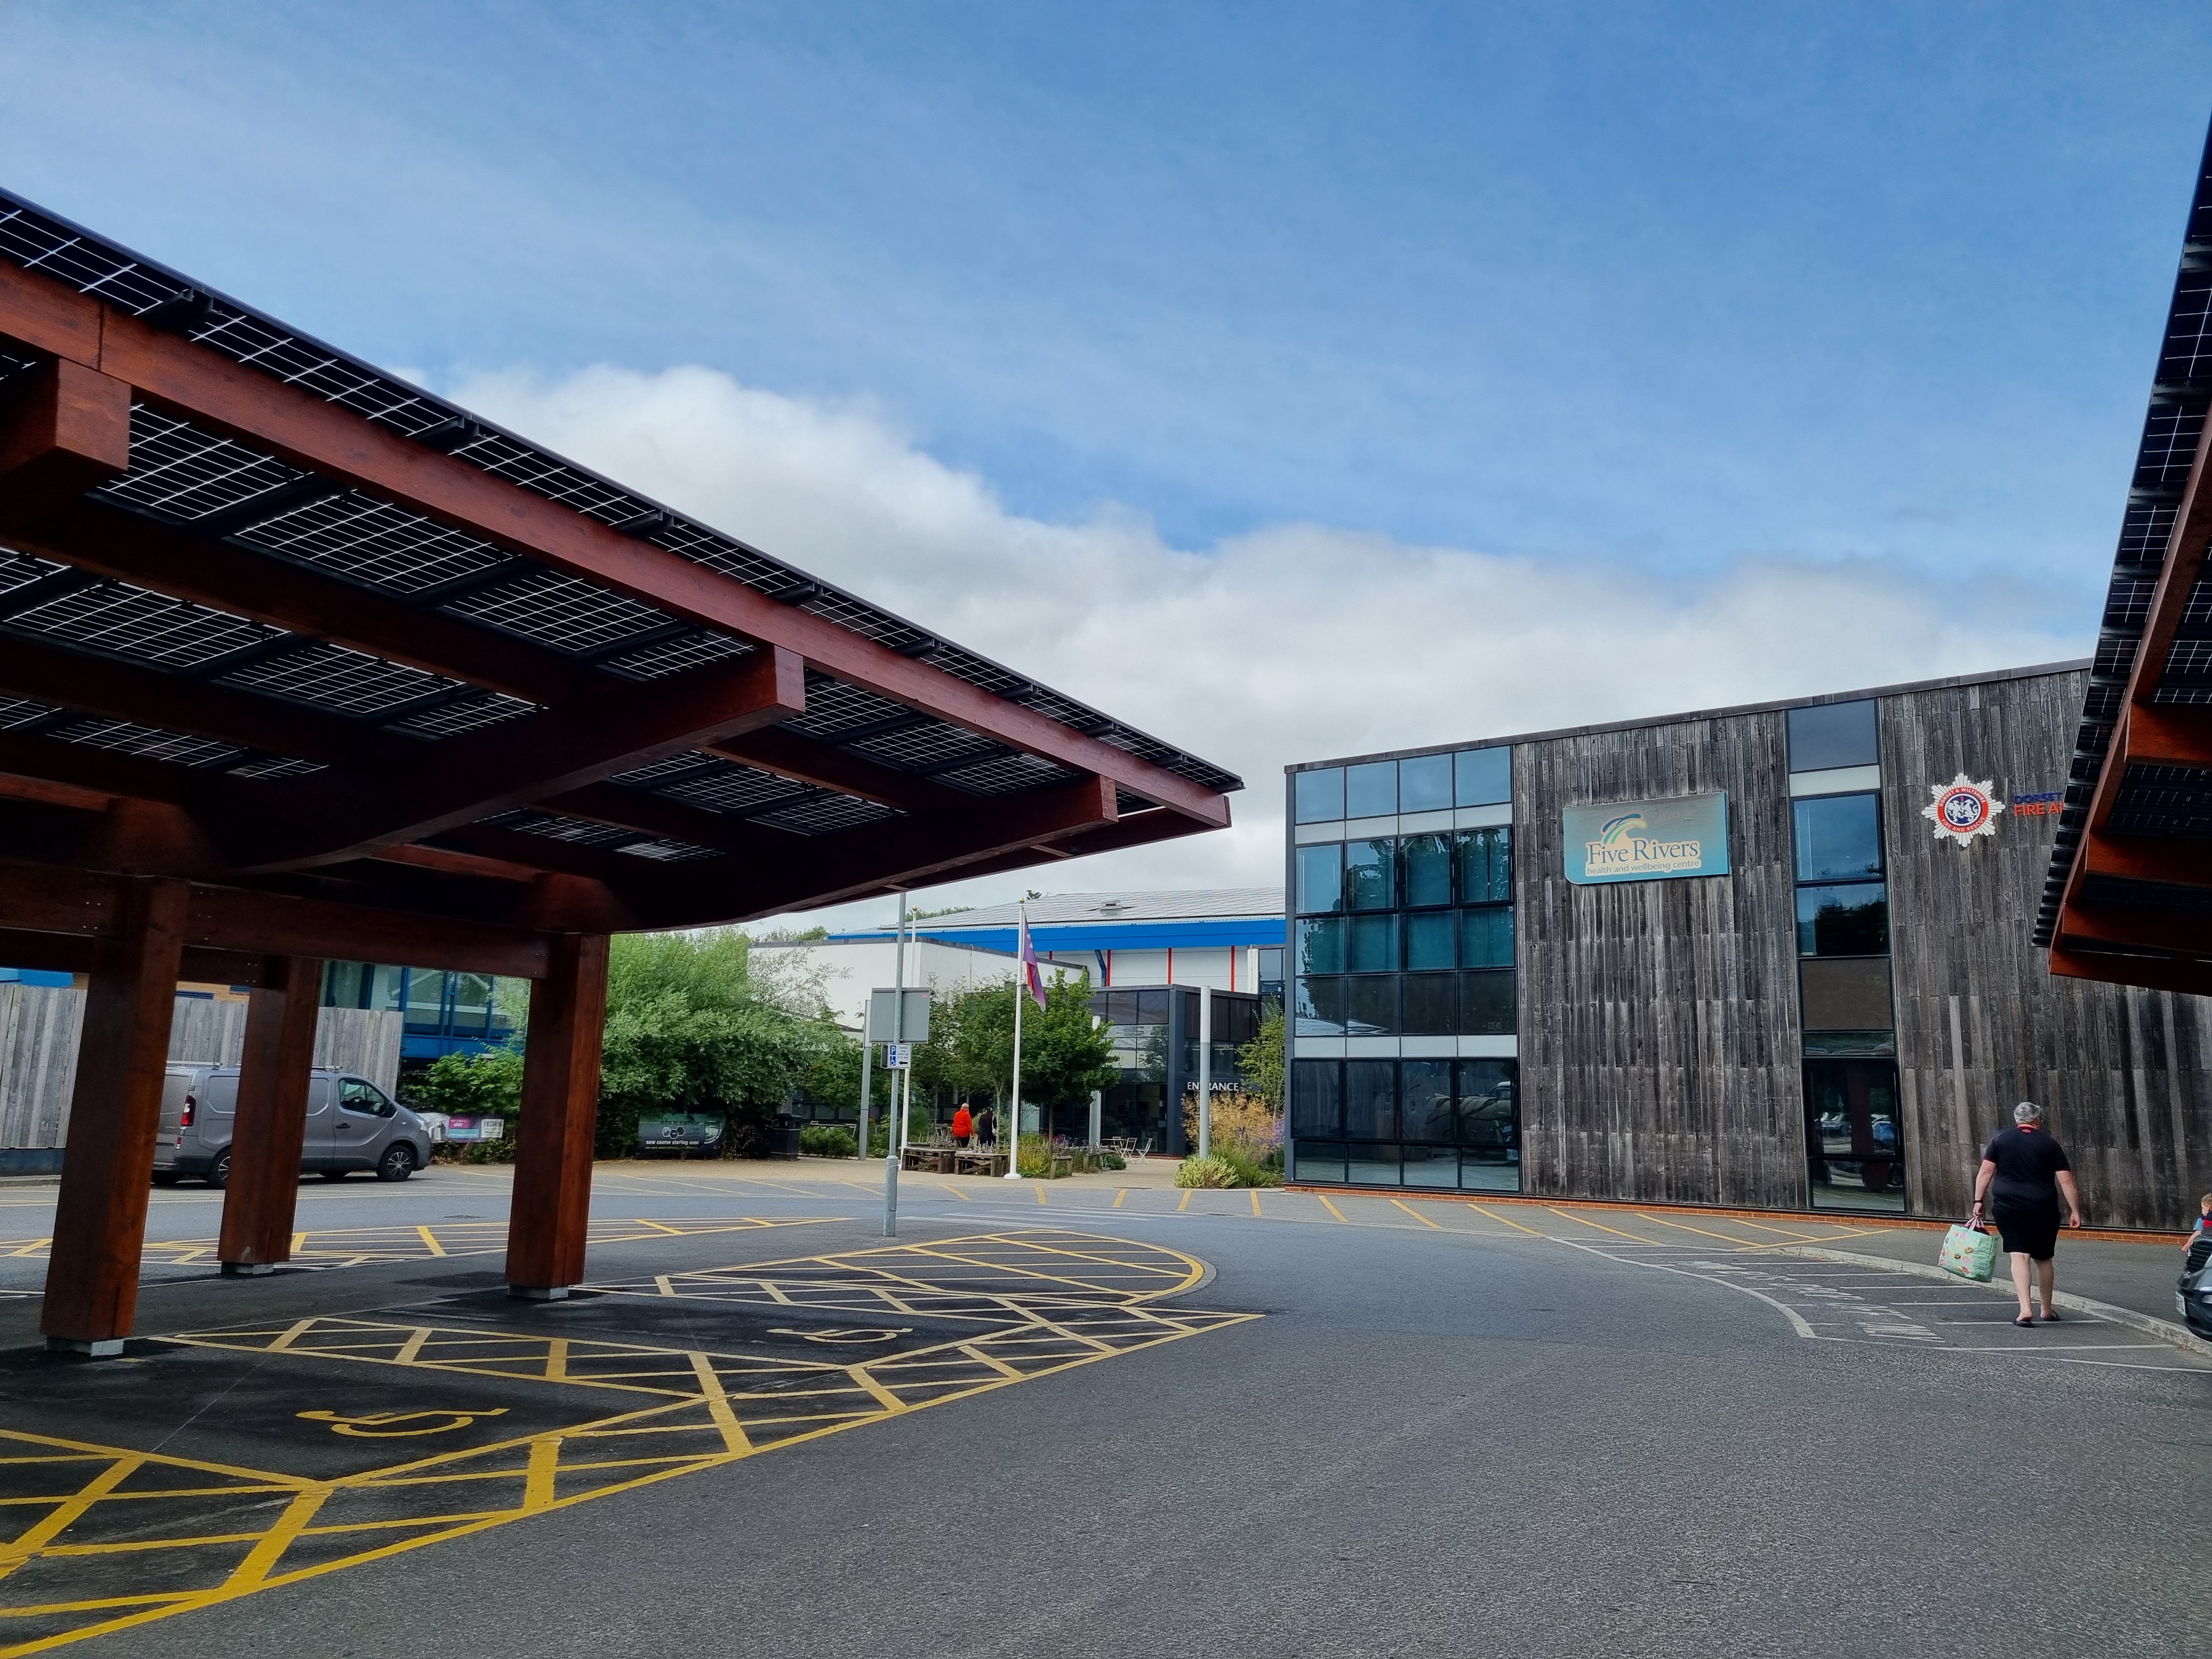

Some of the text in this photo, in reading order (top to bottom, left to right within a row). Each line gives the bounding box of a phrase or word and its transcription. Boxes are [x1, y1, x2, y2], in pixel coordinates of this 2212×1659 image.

[1939, 791, 1954, 806] DORSET
[1961, 788, 1986, 803] WILTSHIRE
[2014, 792, 2063, 804] DORSET
[2014, 803, 2045, 816] FIRE
[1941, 819, 1952, 828] FIRE
[1967, 816, 1985, 831] RESCUE
[1588, 839, 1698, 865] Five Rivers
[1587, 866, 1611, 874] health
[1613, 864, 1629, 873] and
[1631, 862, 1671, 871] wellbeing
[891, 1046, 896, 1054] P
[1187, 1081, 1239, 1091] ENRANCE
